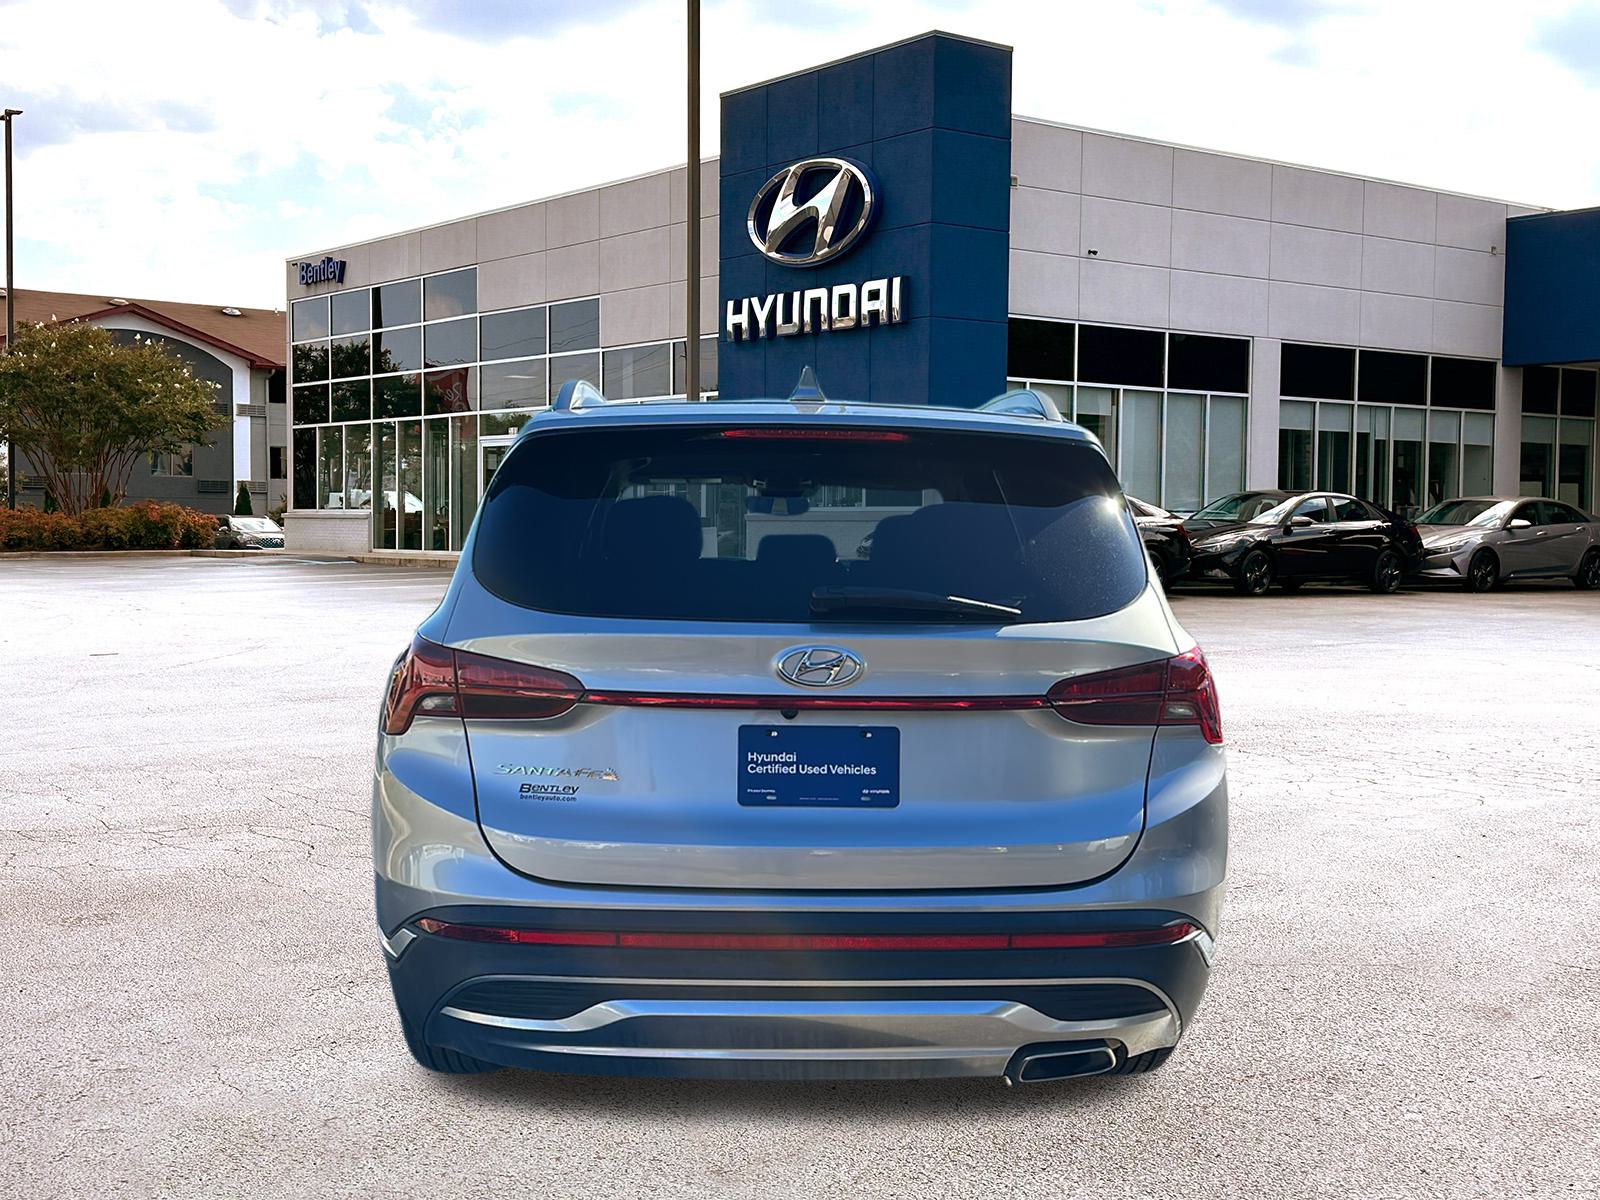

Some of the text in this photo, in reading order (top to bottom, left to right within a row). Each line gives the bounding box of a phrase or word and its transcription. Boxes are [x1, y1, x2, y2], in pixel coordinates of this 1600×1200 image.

[298, 257, 346, 285] Bentley
[726, 276, 903, 342] HYUNDAI
[747, 752, 797, 763] Hyundai
[747, 763, 877, 775] Certified Used Vehicles
[520, 794, 577, 802] bentleyauto.com
